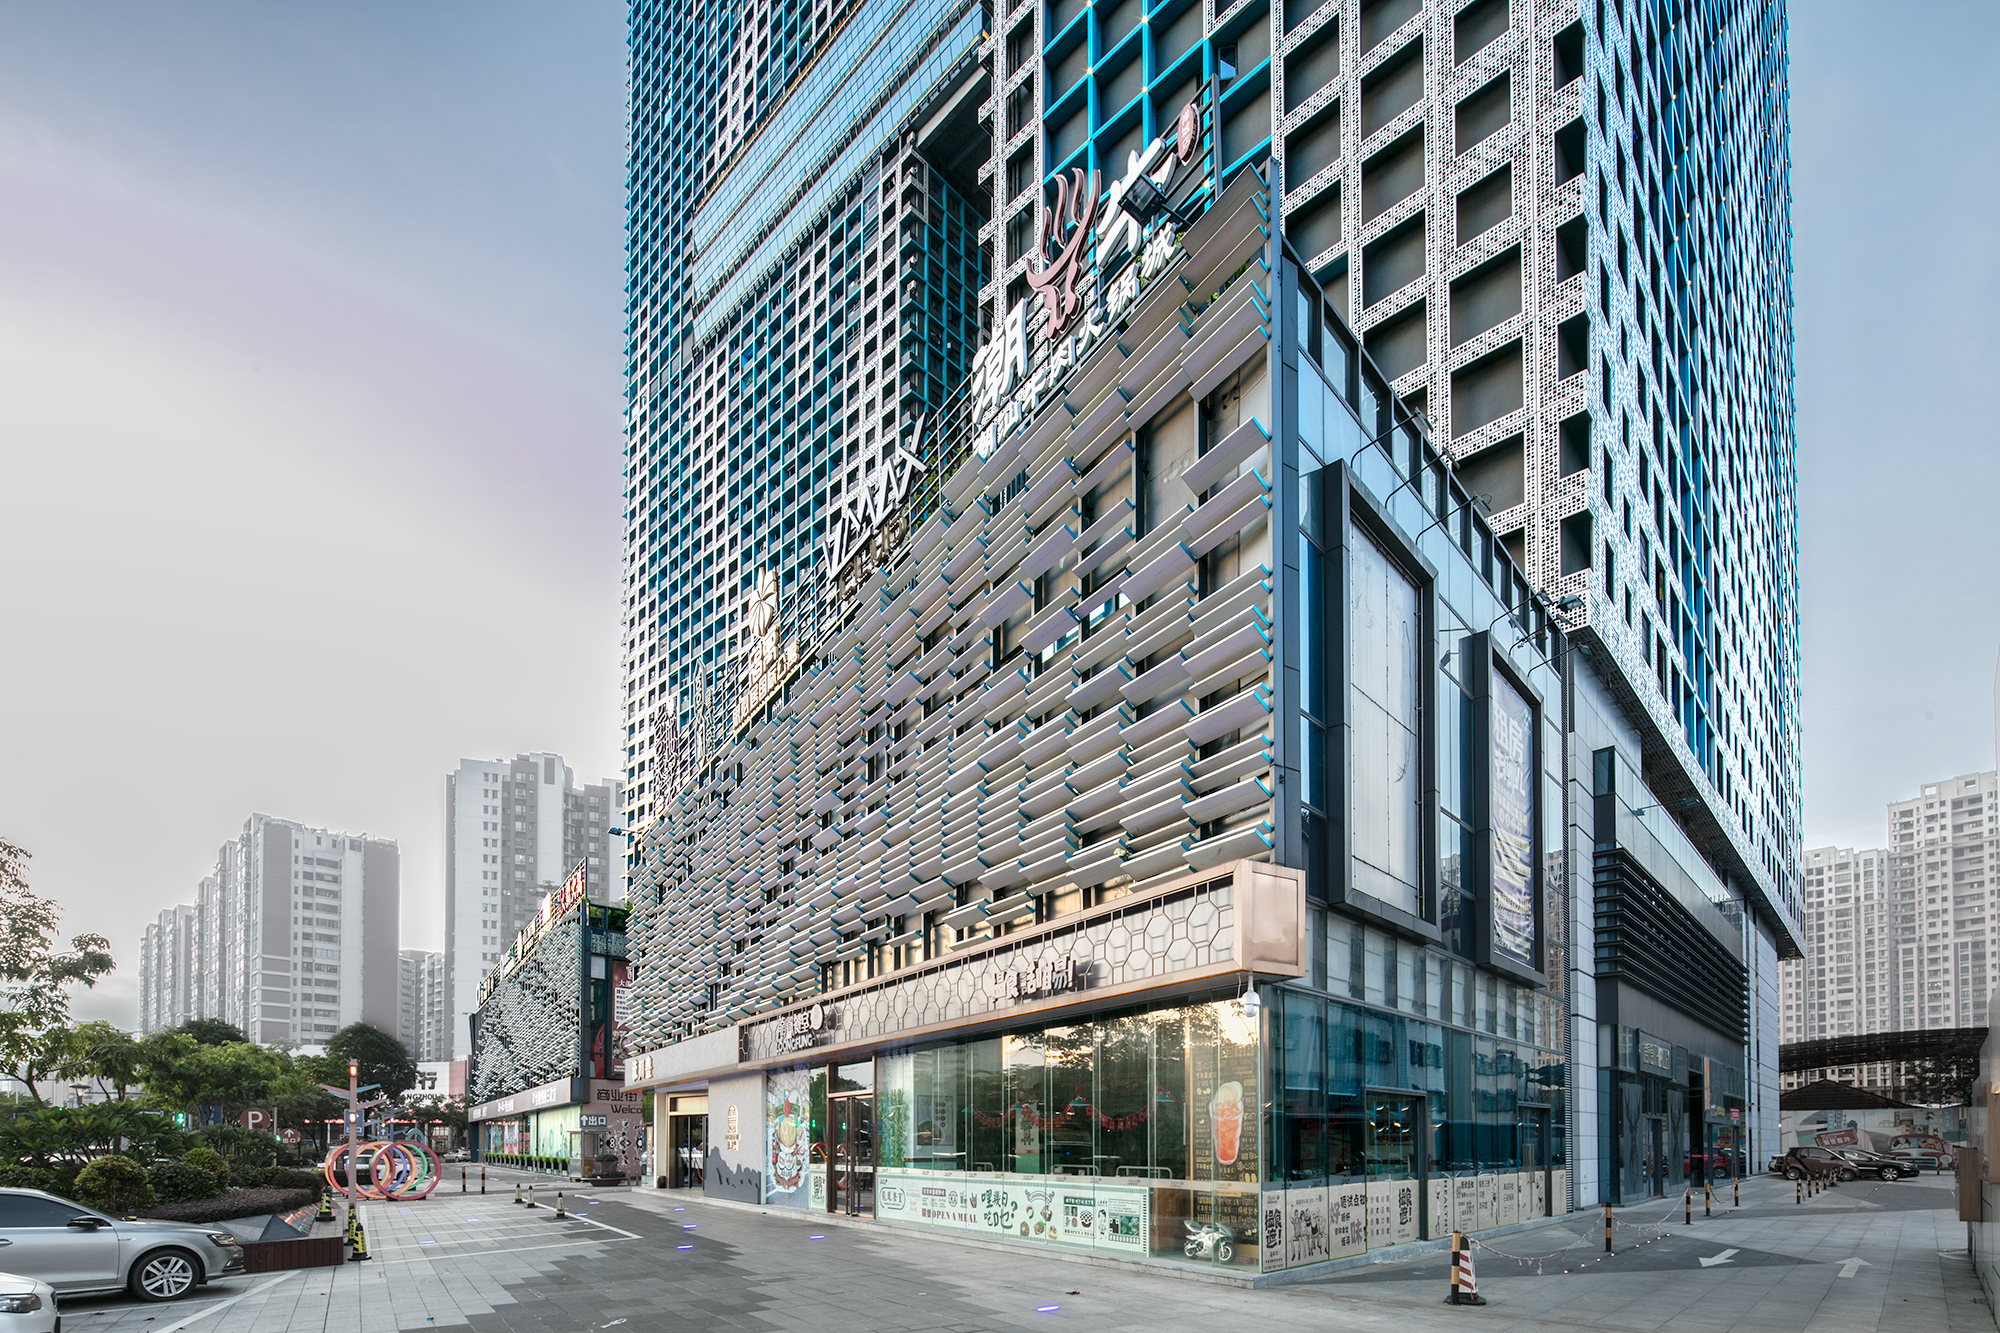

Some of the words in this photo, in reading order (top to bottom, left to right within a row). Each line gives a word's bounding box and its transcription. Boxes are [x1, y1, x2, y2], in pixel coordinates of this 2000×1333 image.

[1493, 702, 1524, 766] 租房
[1494, 748, 1526, 798] 去哪儿
[597, 1088, 638, 1102] 商业街
[248, 1111, 263, 1130] P
[588, 1116, 606, 1125] 出口
[958, 1213, 978, 1223] MEAL
